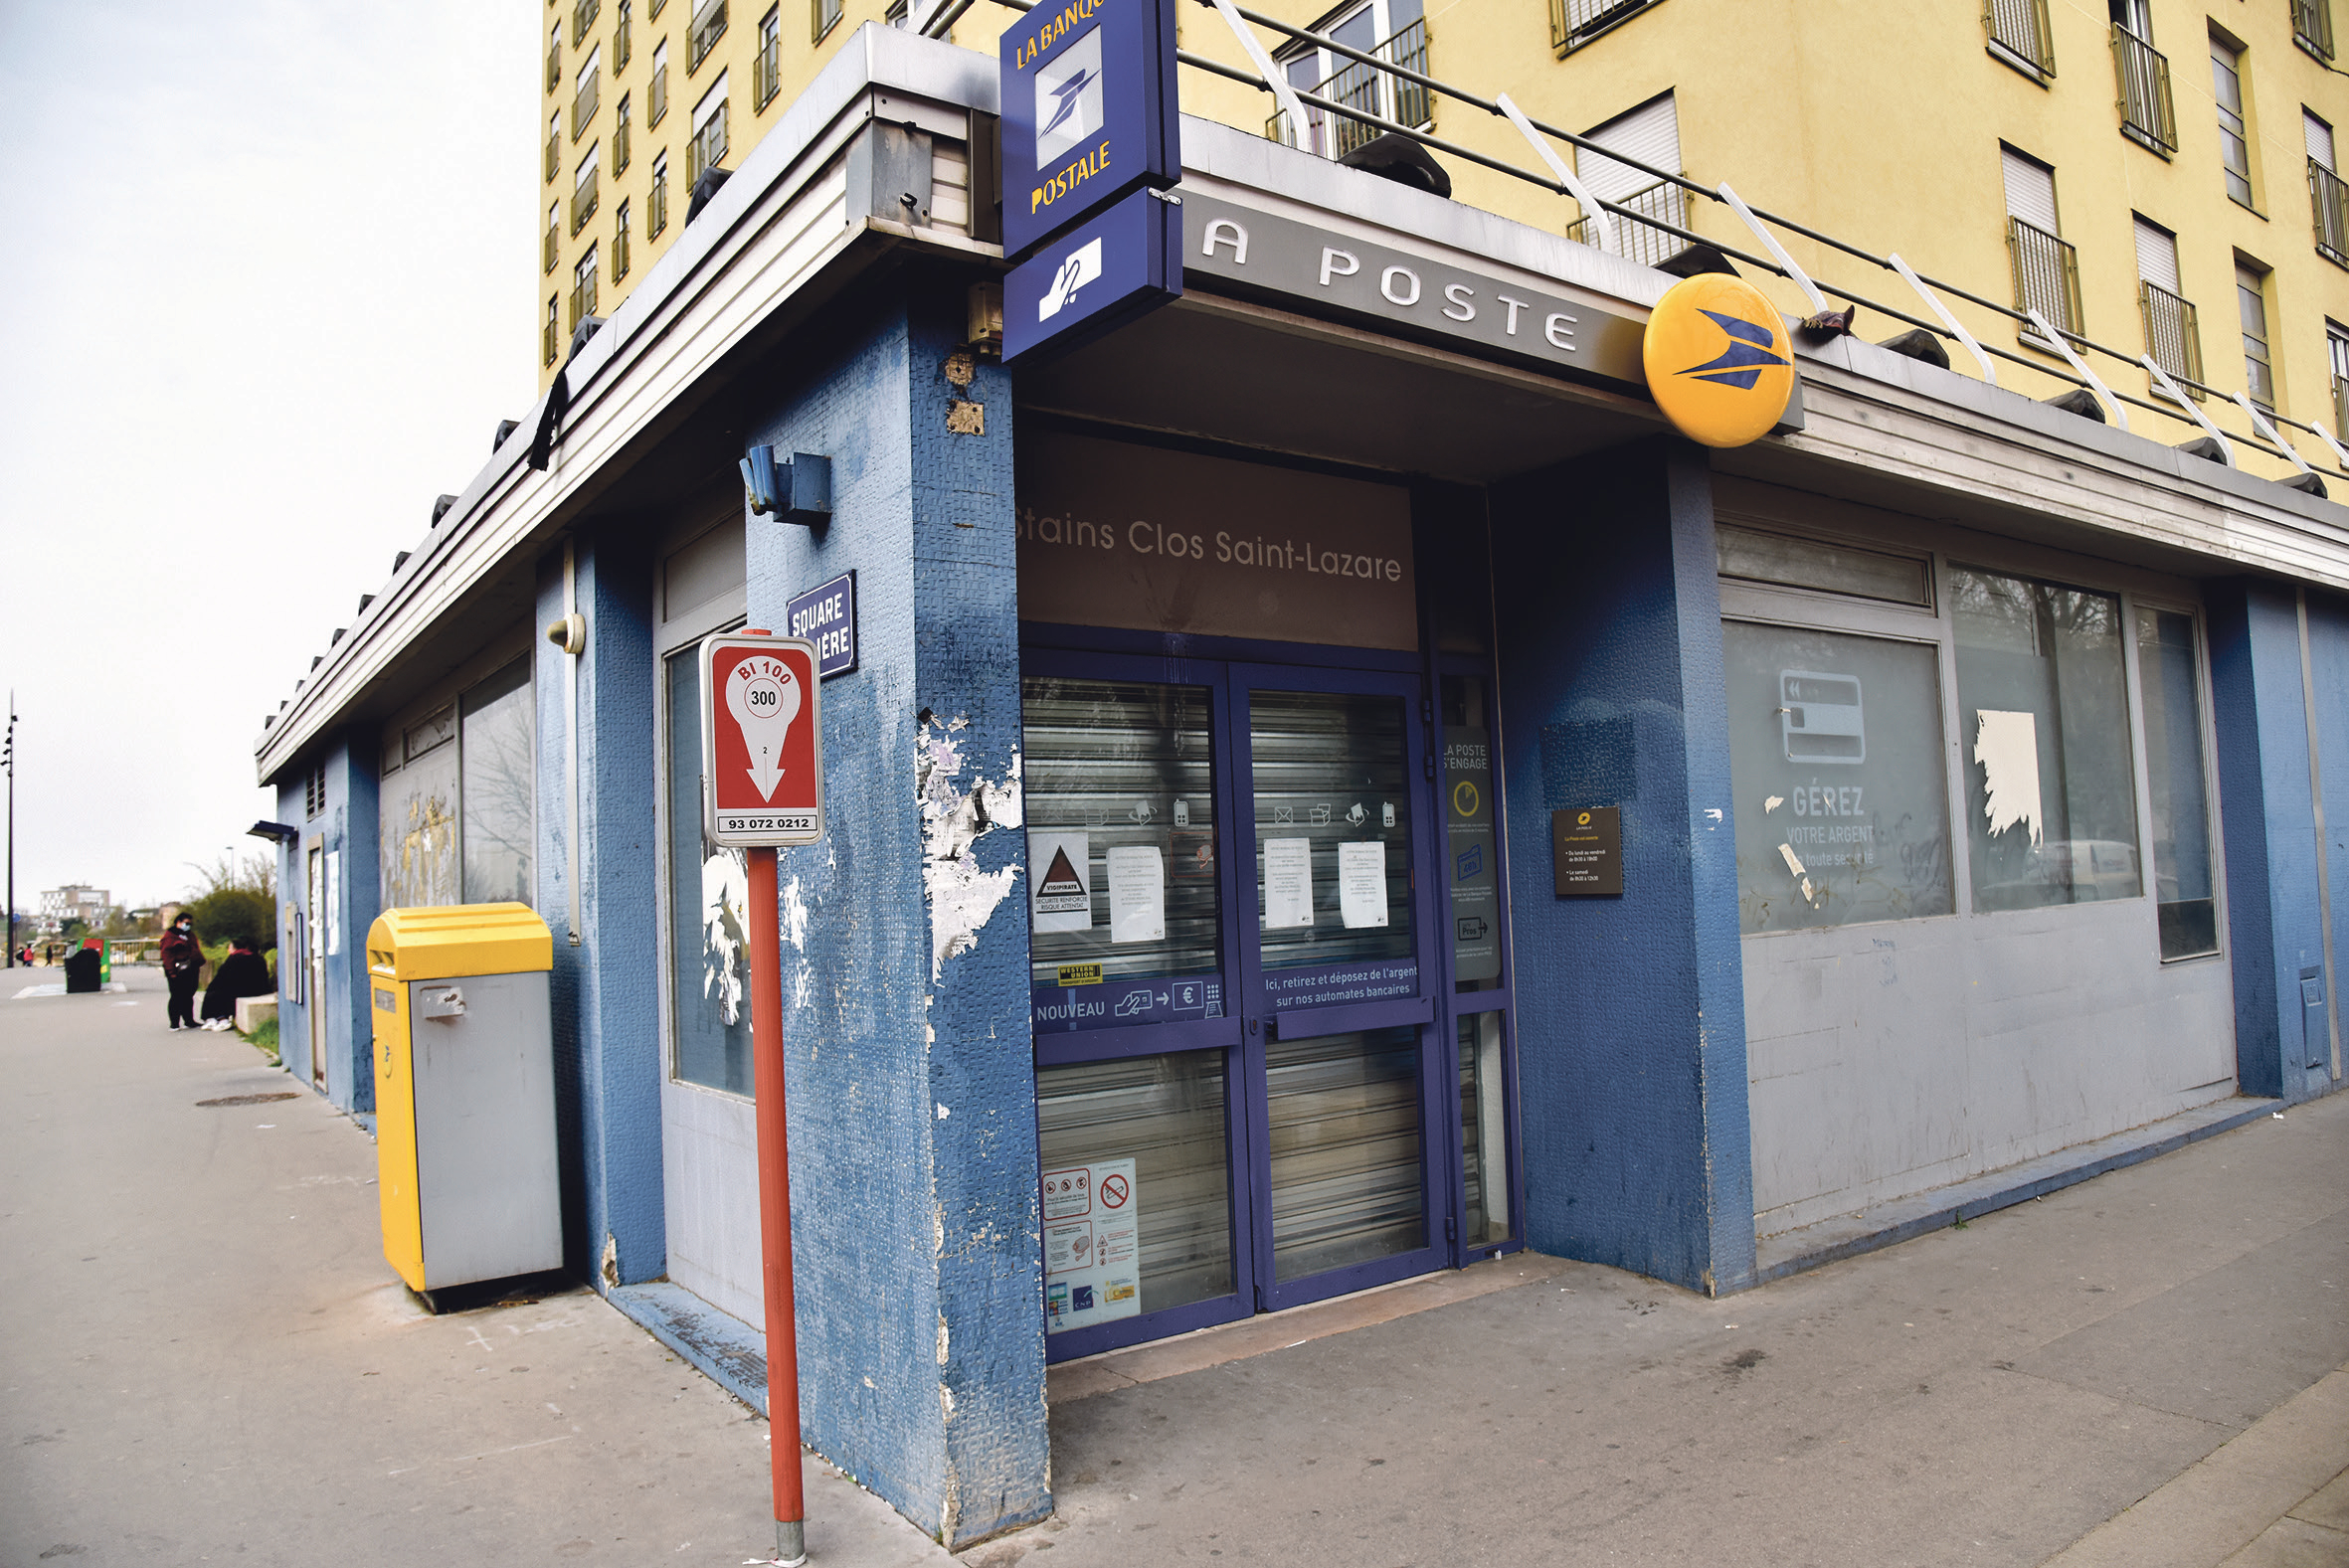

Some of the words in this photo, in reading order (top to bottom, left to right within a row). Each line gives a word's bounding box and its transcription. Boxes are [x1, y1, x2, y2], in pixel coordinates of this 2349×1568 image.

[1016, 35, 1038, 71] LA
[1031, 139, 1112, 215] POSTALE
[1319, 245, 1579, 352] POSTE
[1128, 519, 1204, 560] Clos
[1215, 530, 1402, 583] Saint-Lazare
[792, 592, 843, 638] SQUARE
[737, 661, 757, 681] BI
[762, 660, 793, 686] 100
[750, 690, 777, 706] 300
[763, 746, 769, 755] 2
[1455, 744, 1487, 757] POSTE
[1792, 777, 1865, 816] GÉREZ
[728, 819, 746, 829] 93
[749, 818, 774, 829] 072
[777, 817, 810, 829] 0212
[1786, 826, 1826, 844] VOTRE
[1828, 825, 1874, 844] ARGENT
[1805, 851, 1832, 867] toute
[1060, 965, 1094, 974] WESTERN
[1265, 978, 1281, 991] Ici,
[1283, 975, 1316, 989] retirez
[1318, 974, 1328, 985] et
[1330, 970, 1368, 985] déposez
[1369, 968, 1381, 980] de
[1382, 965, 1418, 981] l'argent
[1276, 997, 1293, 1007] sur
[1295, 993, 1314, 1005] nos
[1315, 987, 1365, 1002] automates
[1366, 983, 1410, 997] bancaires
[1036, 1000, 1106, 1021] NOUVEAU
